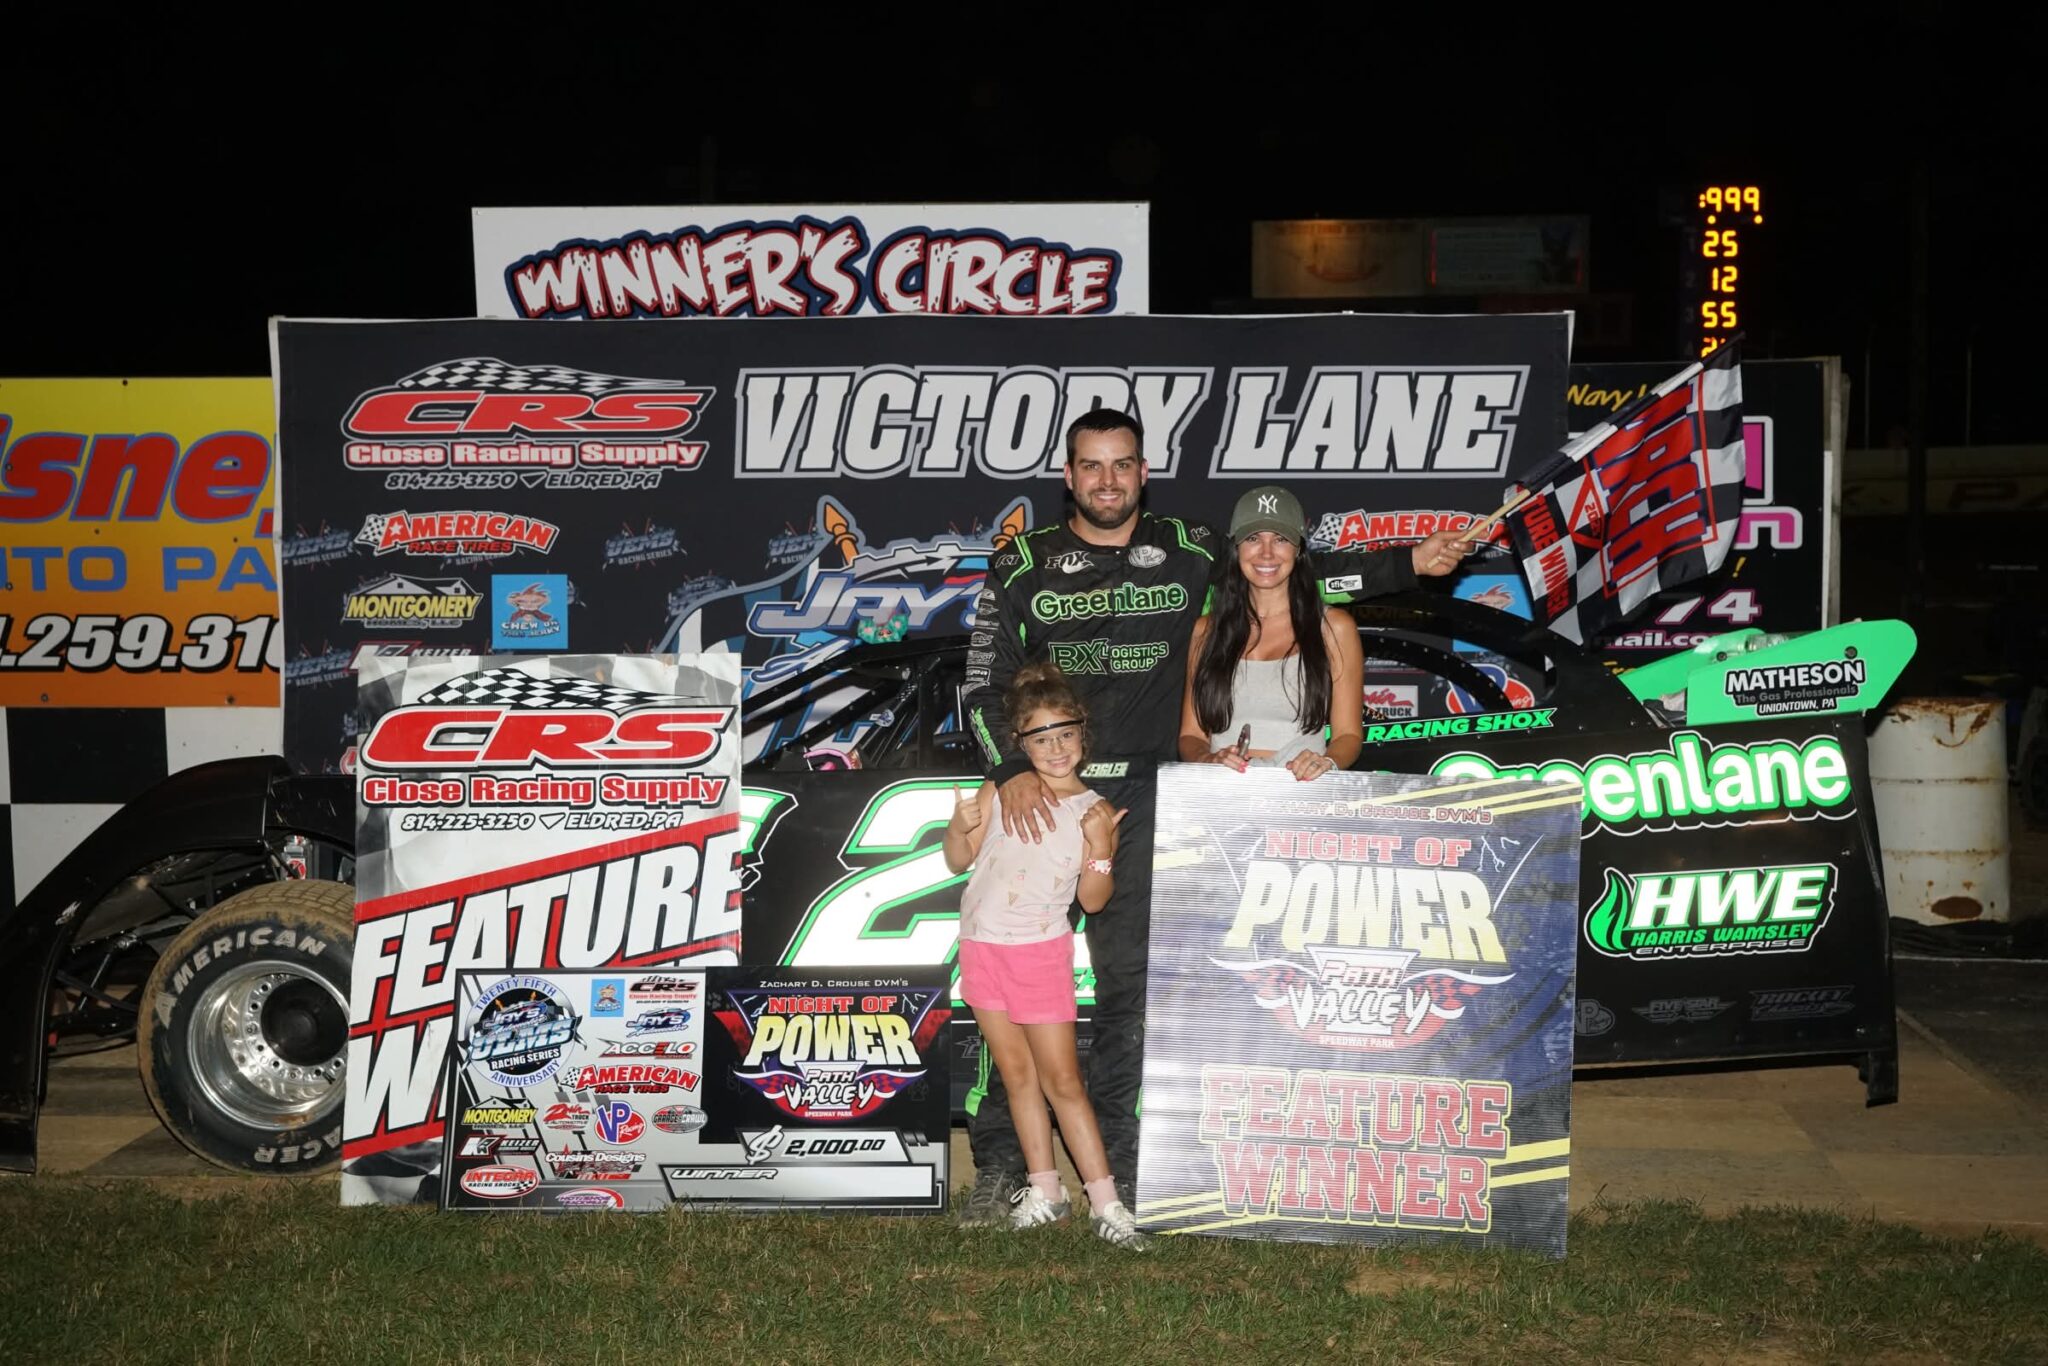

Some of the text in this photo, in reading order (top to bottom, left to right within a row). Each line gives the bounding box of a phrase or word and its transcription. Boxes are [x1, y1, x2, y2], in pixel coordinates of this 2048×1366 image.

[1702, 229, 1739, 257] 25
[509, 219, 1122, 318] WINNER'S CIRCLE
[1711, 265, 1738, 292] 12
[1701, 301, 1737, 328] 55
[1567, 384, 1633, 411] Navy
[342, 388, 715, 439] CRS
[1208, 366, 1530, 478] LANE
[346, 442, 704, 468] Close Racing Supply
[0, 414, 275, 538] sne
[377, 510, 560, 554] AMERICAN
[0, 547, 127, 592] TO
[1045, 551, 1094, 574] FOX
[346, 594, 483, 620] MONTGOMERY
[1032, 583, 1187, 622] Greenlane
[1049, 639, 1109, 675] BX
[1111, 657, 1156, 671] GROUP
[1727, 660, 1868, 693] MATHESON
[1736, 685, 1857, 703] The Gas Professionals
[1758, 698, 1836, 714] UNIONTOWN, PA
[361, 704, 736, 772] CRS
[1366, 708, 1554, 743] RACING SHOX
[363, 775, 729, 807] Close Racing Supply
[1433, 732, 1853, 824] enlane
[1264, 829, 1472, 867] NIGHT OF
[1222, 861, 1508, 963] POWER
[1624, 866, 1830, 930] HWE
[350, 834, 742, 1026] FEATURE
[1630, 923, 1813, 947] HARRIS WAMSLEY
[1636, 938, 1806, 955] ENTERPRISE
[155, 926, 328, 1030] AMERICAN
[629, 981, 700, 993] CRS
[759, 980, 807, 989] ZACHARY
[826, 980, 870, 988] CROUSE
[476, 978, 558, 1010] TWENTY FIFTH
[768, 996, 897, 1014] NIGHT OF
[1288, 983, 1431, 1035] VALLEY
[603, 1041, 698, 1056] ACCELO
[743, 1014, 921, 1066] POWER
[1370, 1036, 1395, 1048] PARK
[491, 1048, 560, 1071] RACING SERIES
[491, 1060, 561, 1086] ANNIVERSARY
[575, 1064, 701, 1093] AMERICAN
[595, 1083, 670, 1094] RACE TIRES
[804, 1069, 856, 1084] PATH
[784, 1080, 875, 1109] VALLEY
[463, 1108, 538, 1125] MONTGOMERY
[595, 1101, 632, 1143] VP
[1202, 1065, 1510, 1154] FEATURE
[501, 1139, 540, 1147] KEIZER
[620, 1123, 645, 1138] Racing
[745, 1125, 886, 1164] $ 2,000.00
[545, 1151, 646, 1164] Cousins Designs
[671, 1168, 778, 1180] WINNER
[1218, 1141, 1490, 1230] WINNER
